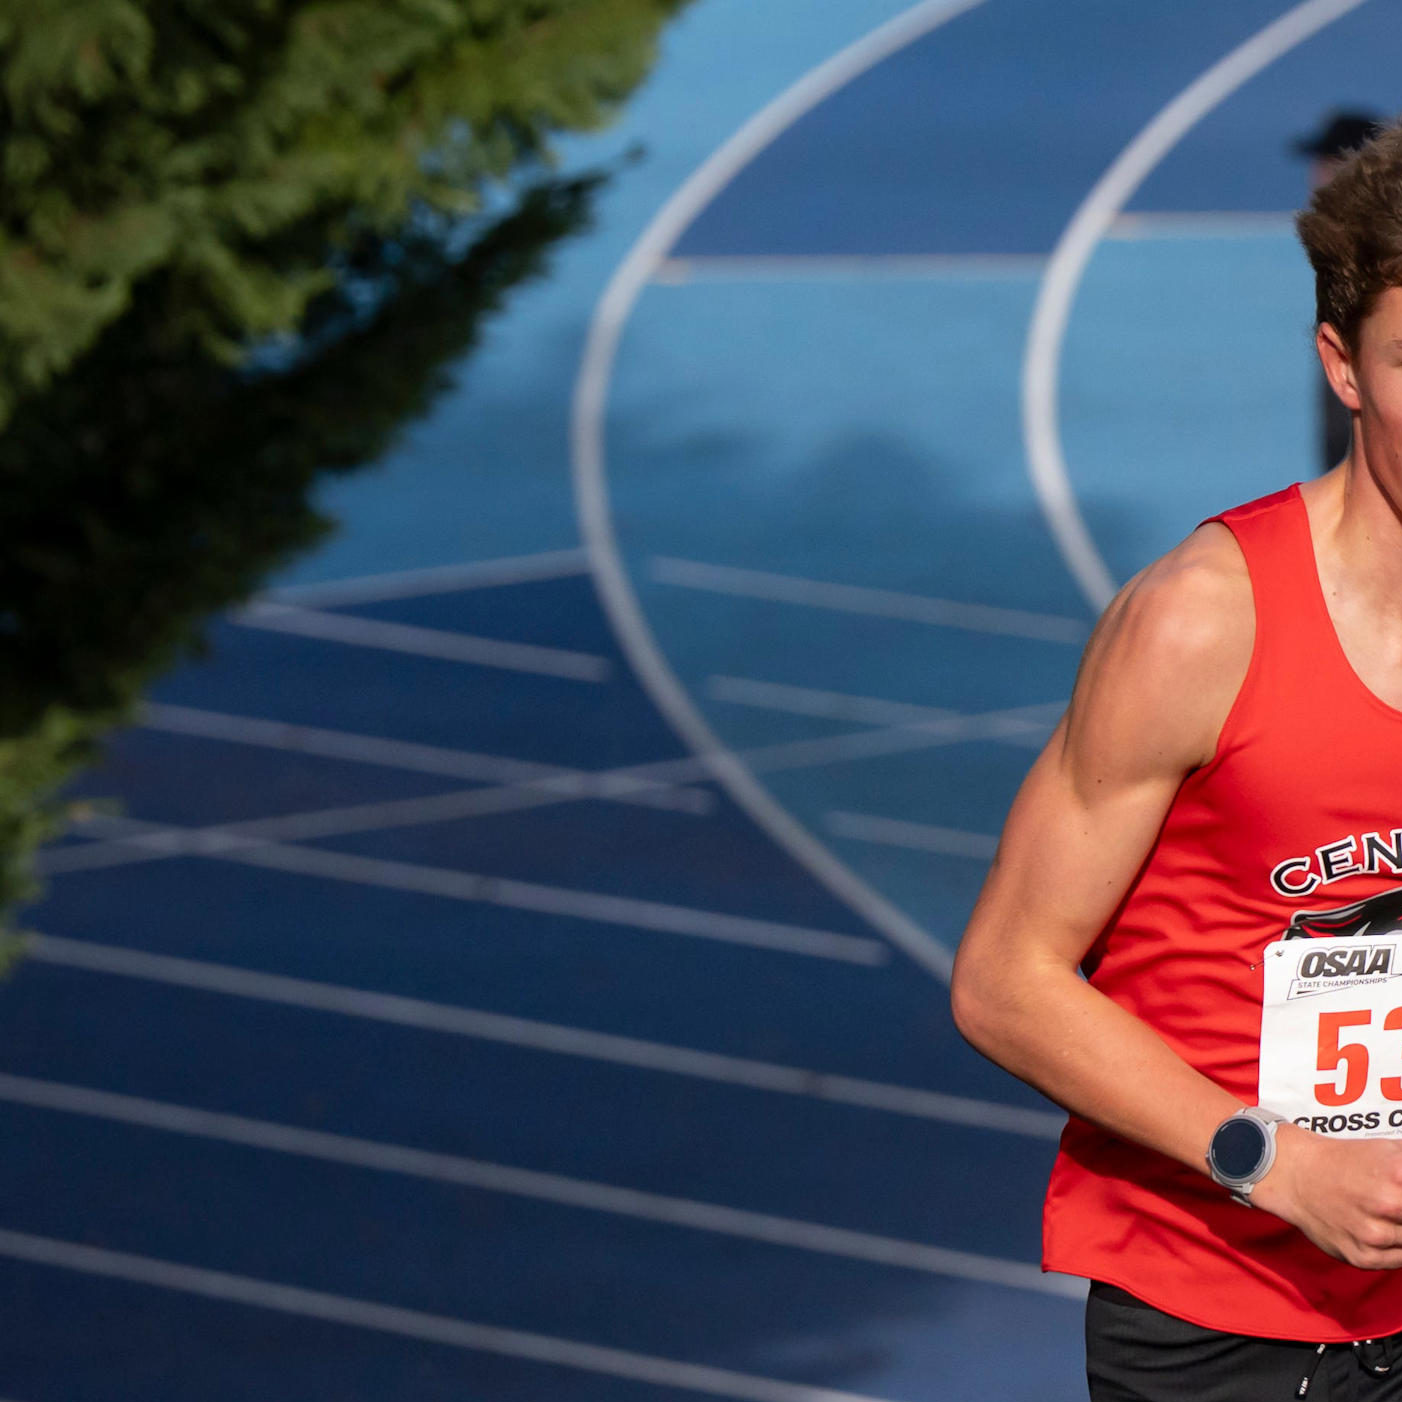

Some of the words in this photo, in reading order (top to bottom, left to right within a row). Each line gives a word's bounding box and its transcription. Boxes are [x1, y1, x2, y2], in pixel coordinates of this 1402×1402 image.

[1300, 948, 1392, 979] OSAA
[1298, 980, 1322, 989] STATE
[1323, 976, 1388, 988] CHAMPIONSHIPS
[1293, 1112, 1381, 1134] CROSS
